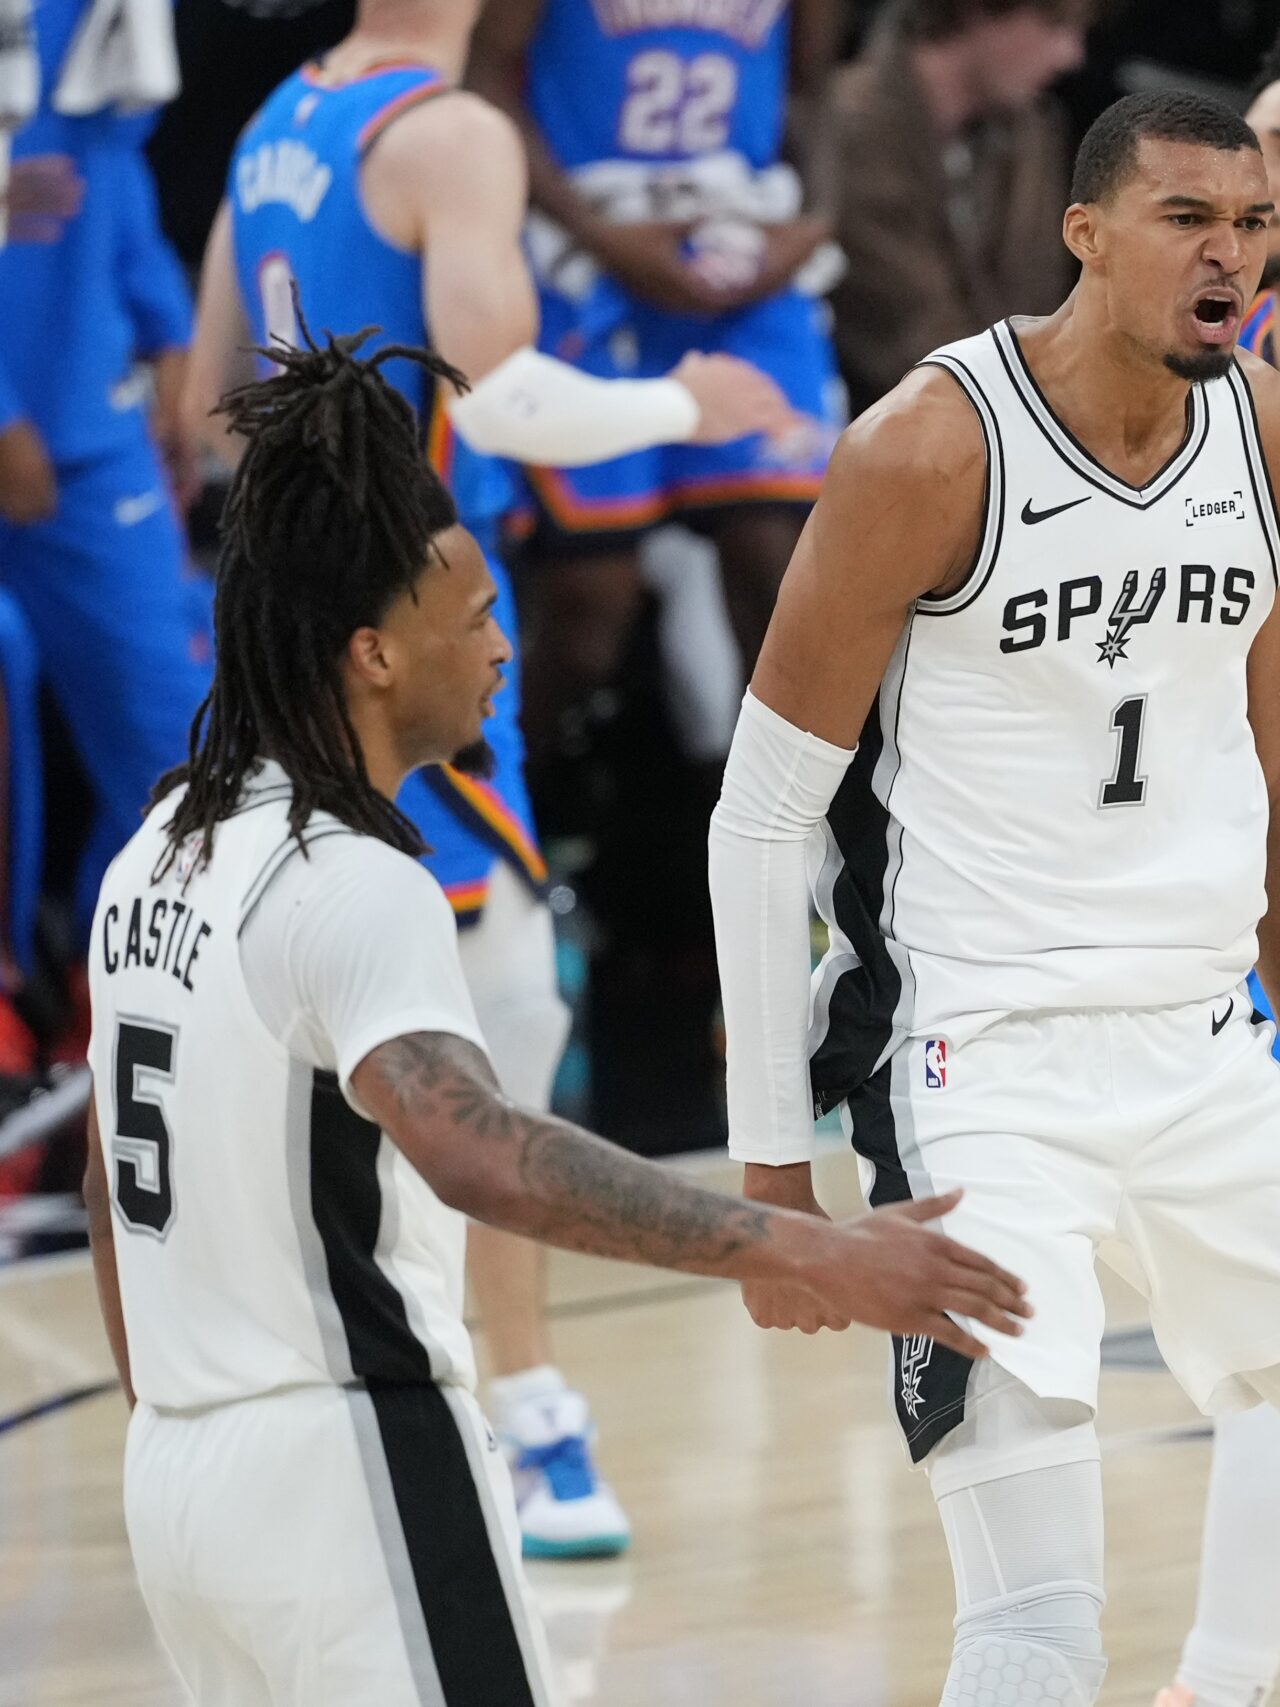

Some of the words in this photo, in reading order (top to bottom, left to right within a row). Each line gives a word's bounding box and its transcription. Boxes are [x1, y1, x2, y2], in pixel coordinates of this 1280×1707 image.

[619, 50, 738, 153] 22
[1192, 500, 1236, 518] LEDGER
[999, 565, 1255, 669] SPURS
[1097, 693, 1148, 809] 1
[103, 897, 211, 993] CASTLE
[112, 1011, 180, 1244] 5
